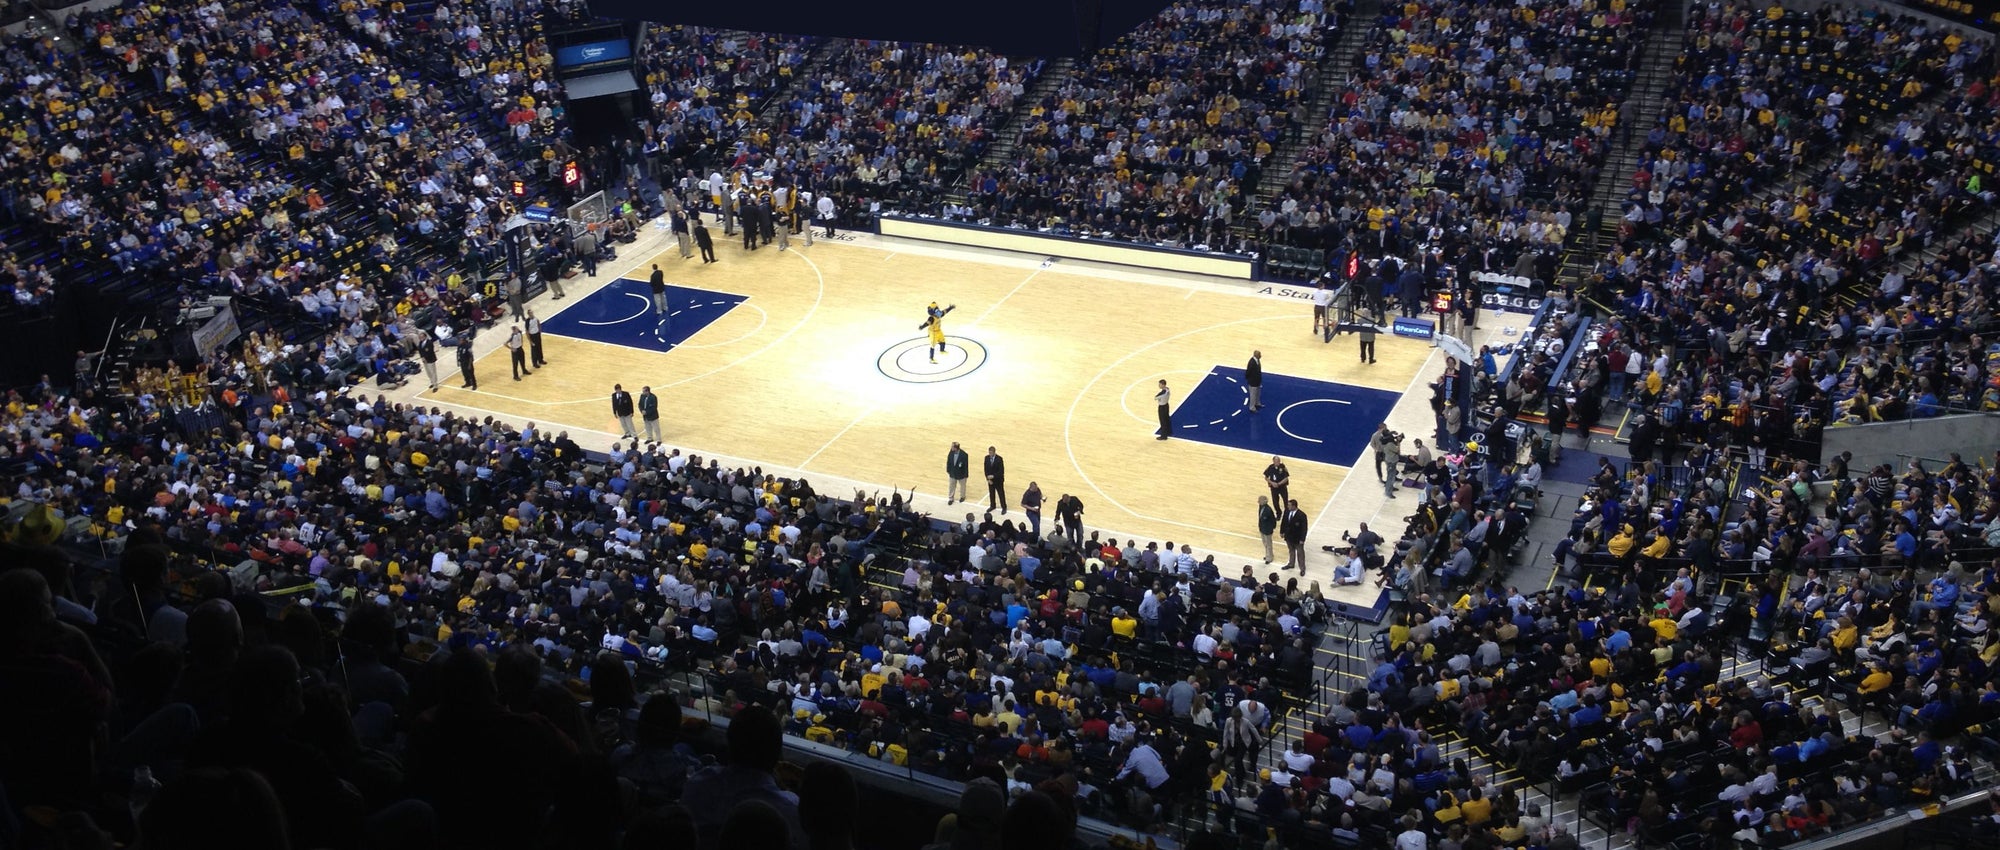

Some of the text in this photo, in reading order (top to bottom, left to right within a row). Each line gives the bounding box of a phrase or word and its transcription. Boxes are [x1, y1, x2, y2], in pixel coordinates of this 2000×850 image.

[565, 168, 577, 184] 20
[1257, 286, 1272, 295] A
[1436, 300, 1449, 309] 20
